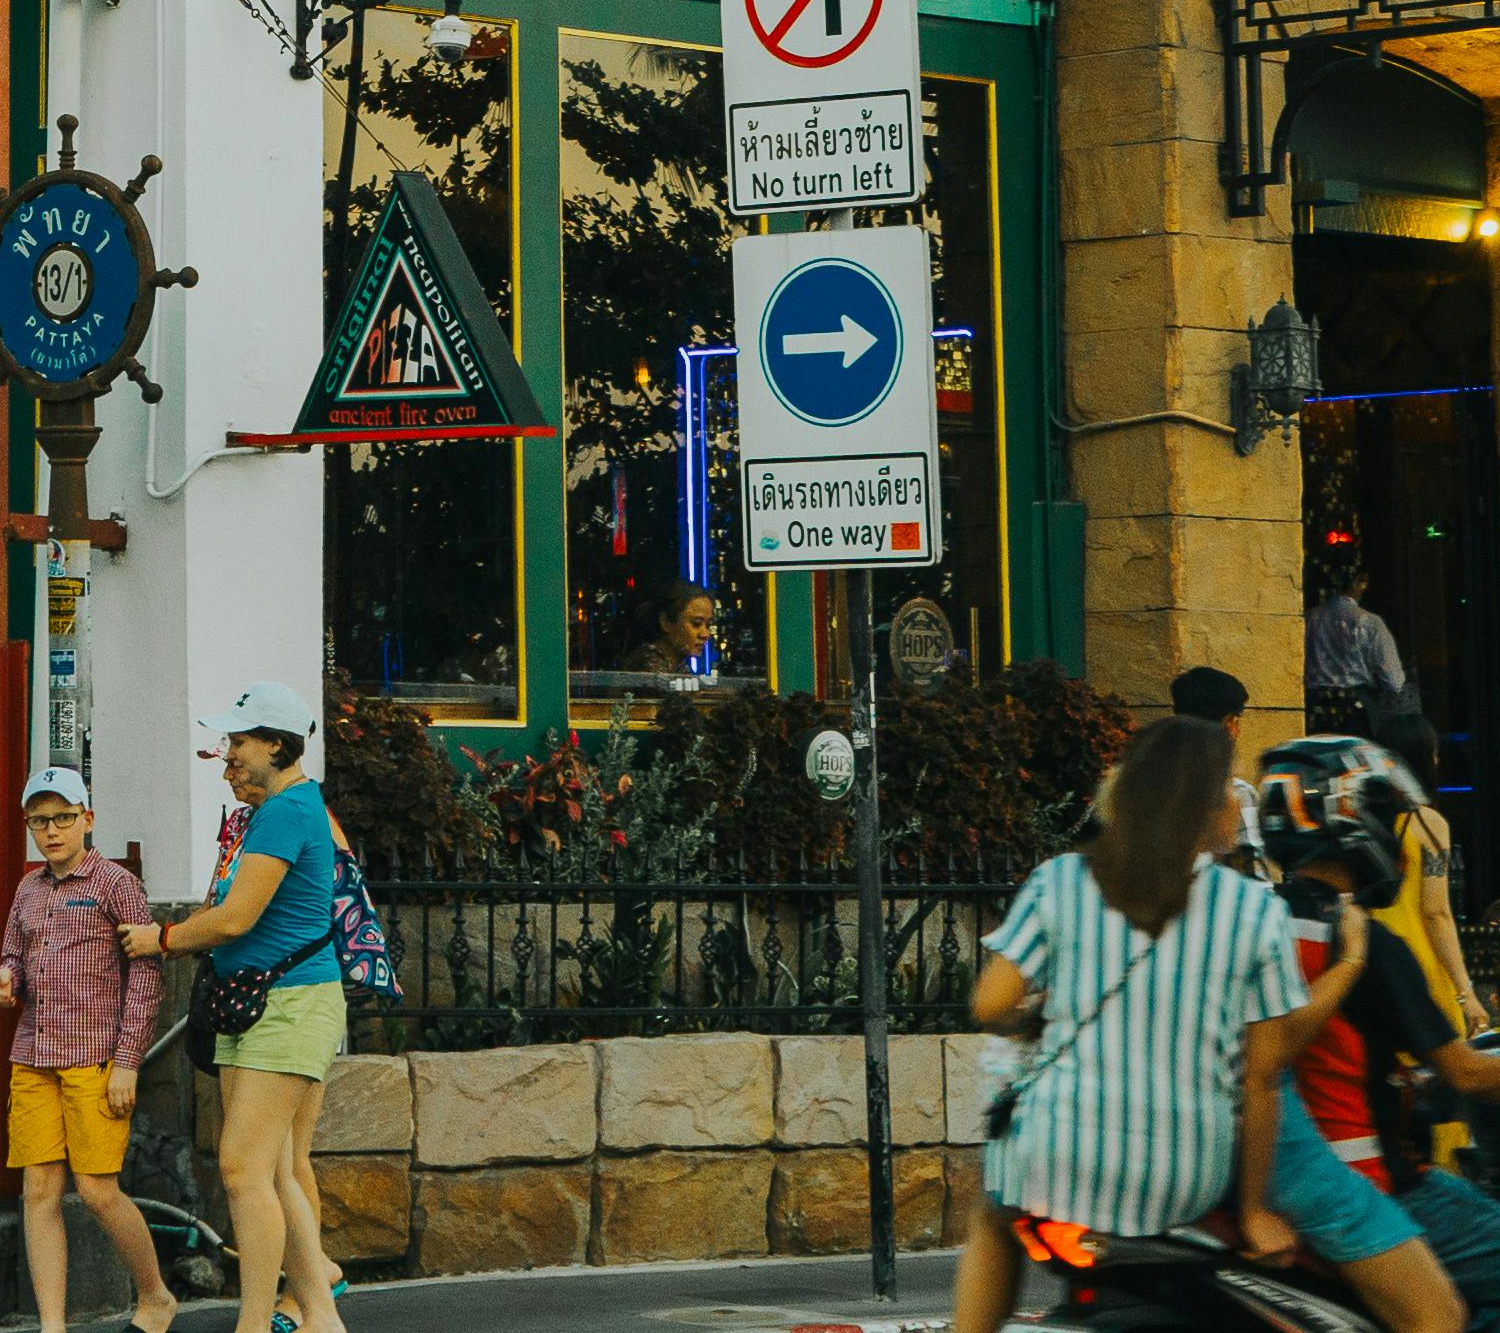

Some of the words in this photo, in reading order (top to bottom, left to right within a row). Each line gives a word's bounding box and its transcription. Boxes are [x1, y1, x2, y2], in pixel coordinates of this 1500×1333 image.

[740, 106, 904, 162] ห้ามเลี้ยวซ้าย
[752, 172, 784, 199] No
[793, 171, 842, 196] turn
[853, 162, 893, 191] left
[13, 206, 111, 259] พัทยา
[25, 312, 104, 347] PATTAYA
[325, 235, 394, 394] original
[403, 235, 483, 391] neapolitan
[368, 303, 440, 385] PIZZA
[329, 405, 393, 426] ancient
[399, 401, 427, 426] fire
[434, 405, 477, 423] oven
[752, 465, 922, 511] เดินรถทางเดียว
[787, 520, 833, 548] One
[841, 523, 887, 553] way
[902, 634, 943, 659] HOPS
